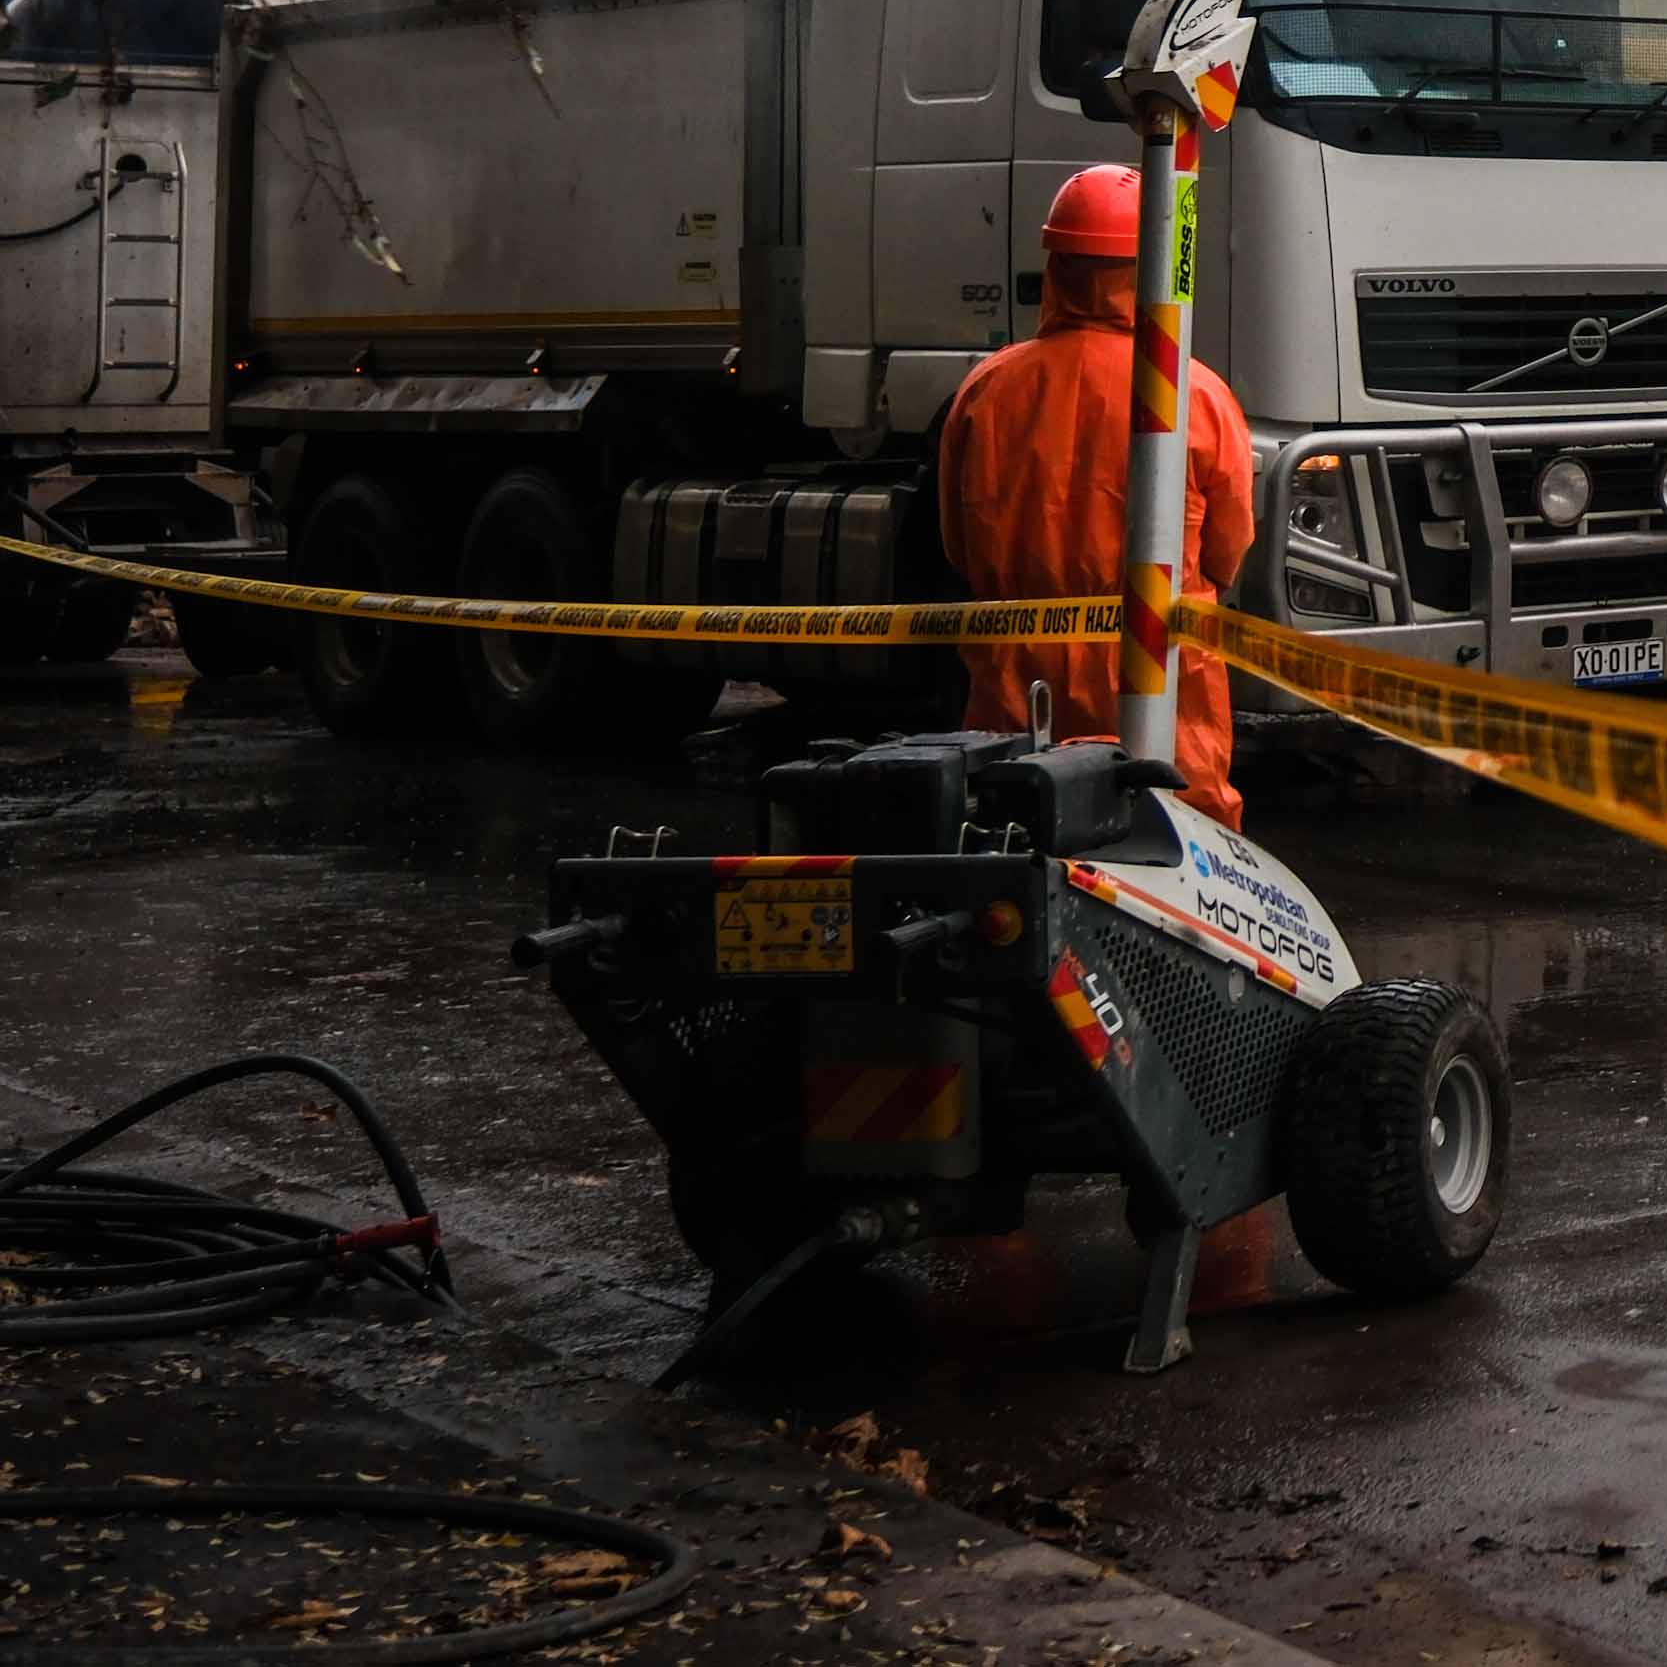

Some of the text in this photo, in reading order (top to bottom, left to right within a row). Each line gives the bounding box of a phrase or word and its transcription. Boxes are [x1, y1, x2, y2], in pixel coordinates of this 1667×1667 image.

[1179, 224, 1193, 296] BOSS
[1368, 278, 1456, 293] VOLVO
[695, 610, 892, 637] DANGER ASBESTOS DUST HAZARD
[909, 604, 1121, 635] DANGER ASBESTOS DUST HAZA
[1206, 850, 1309, 924] Metropolitan
[1197, 889, 1335, 984] MOTOFOG
